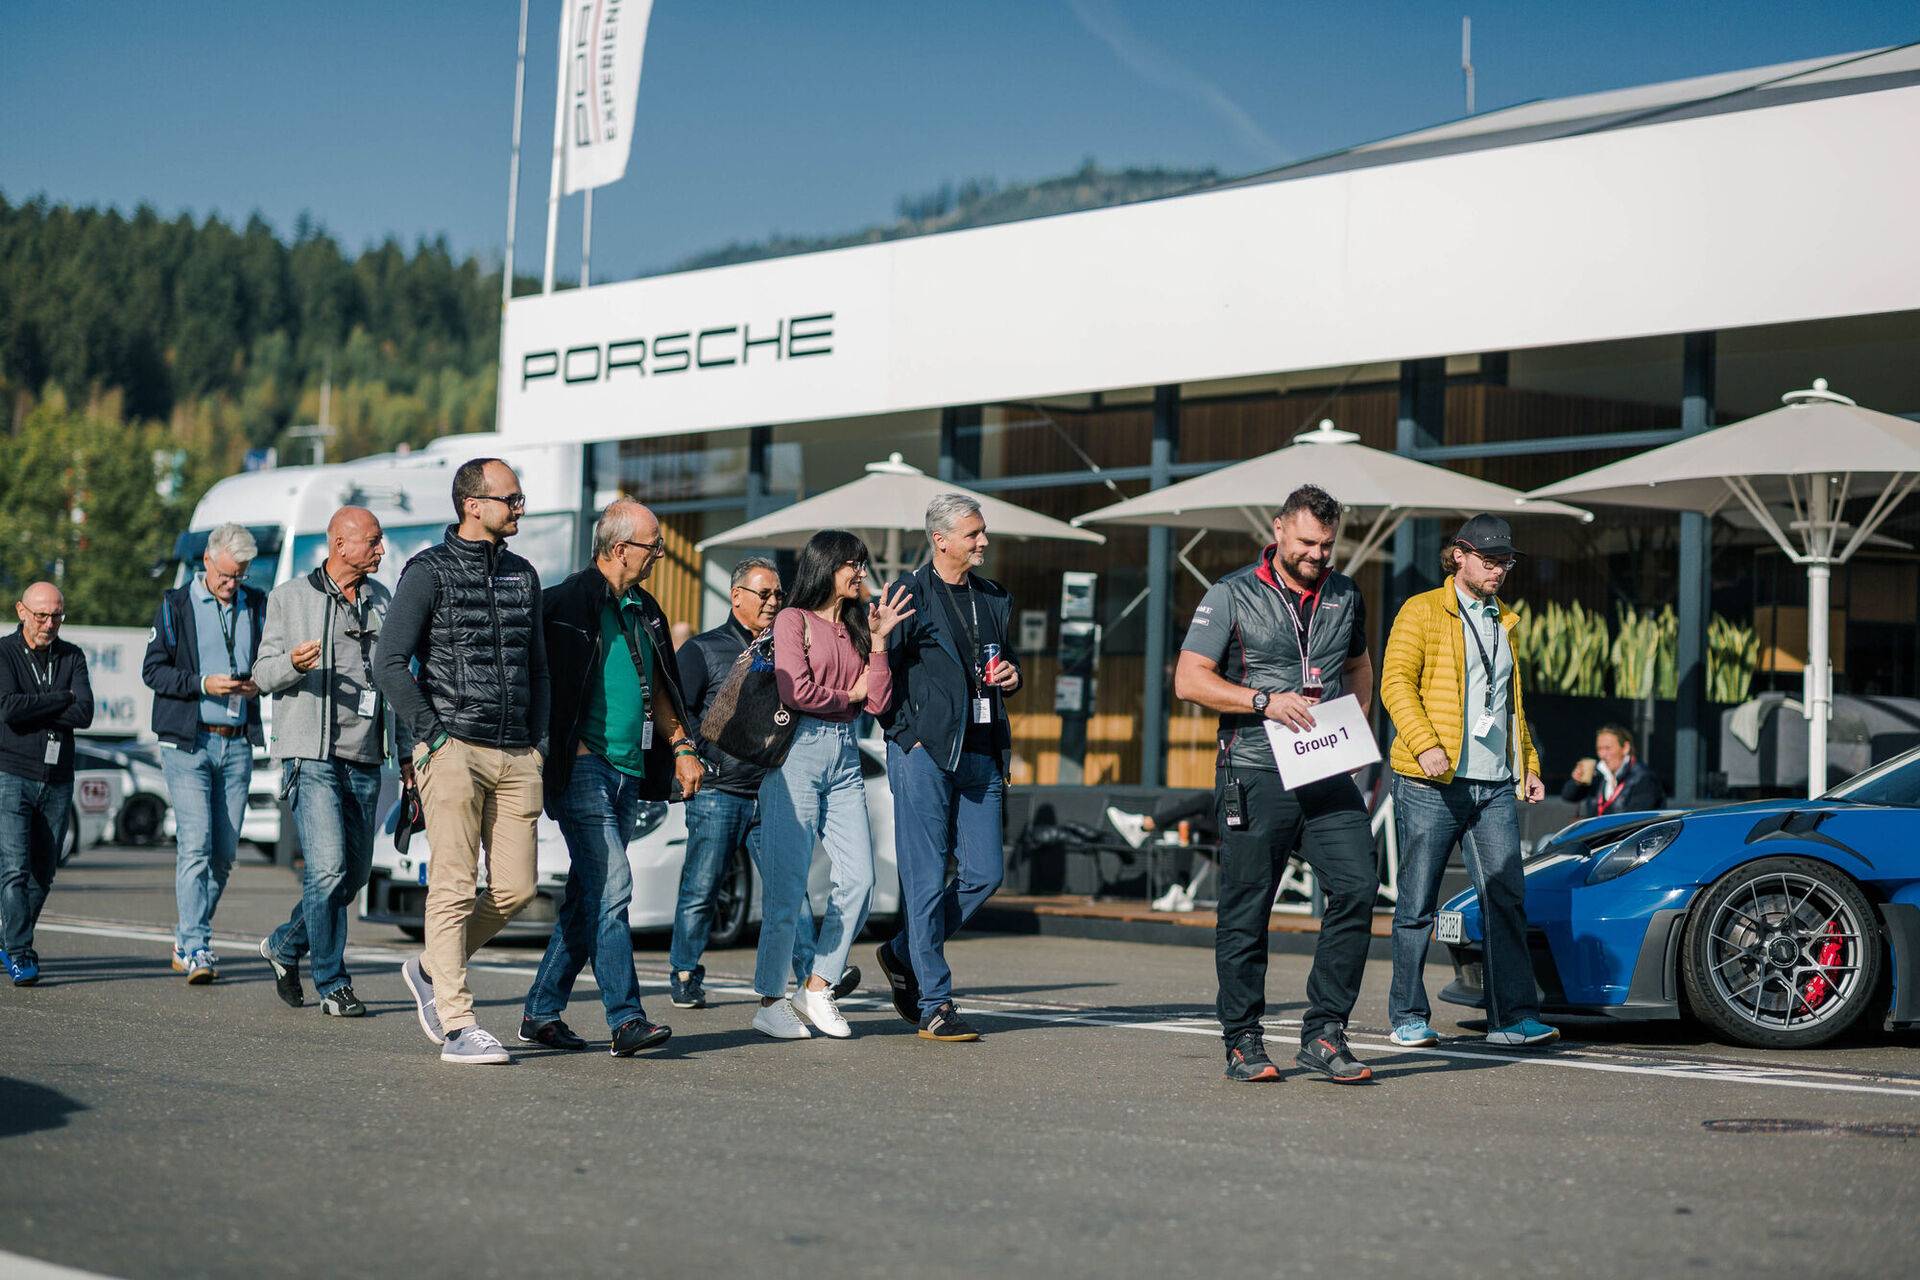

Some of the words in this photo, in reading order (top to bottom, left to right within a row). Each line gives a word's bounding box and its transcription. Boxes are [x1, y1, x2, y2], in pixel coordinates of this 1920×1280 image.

[521, 312, 835, 391] PORSCHE
[1293, 731, 1337, 755] Group
[1340, 727, 1348, 739] 1
